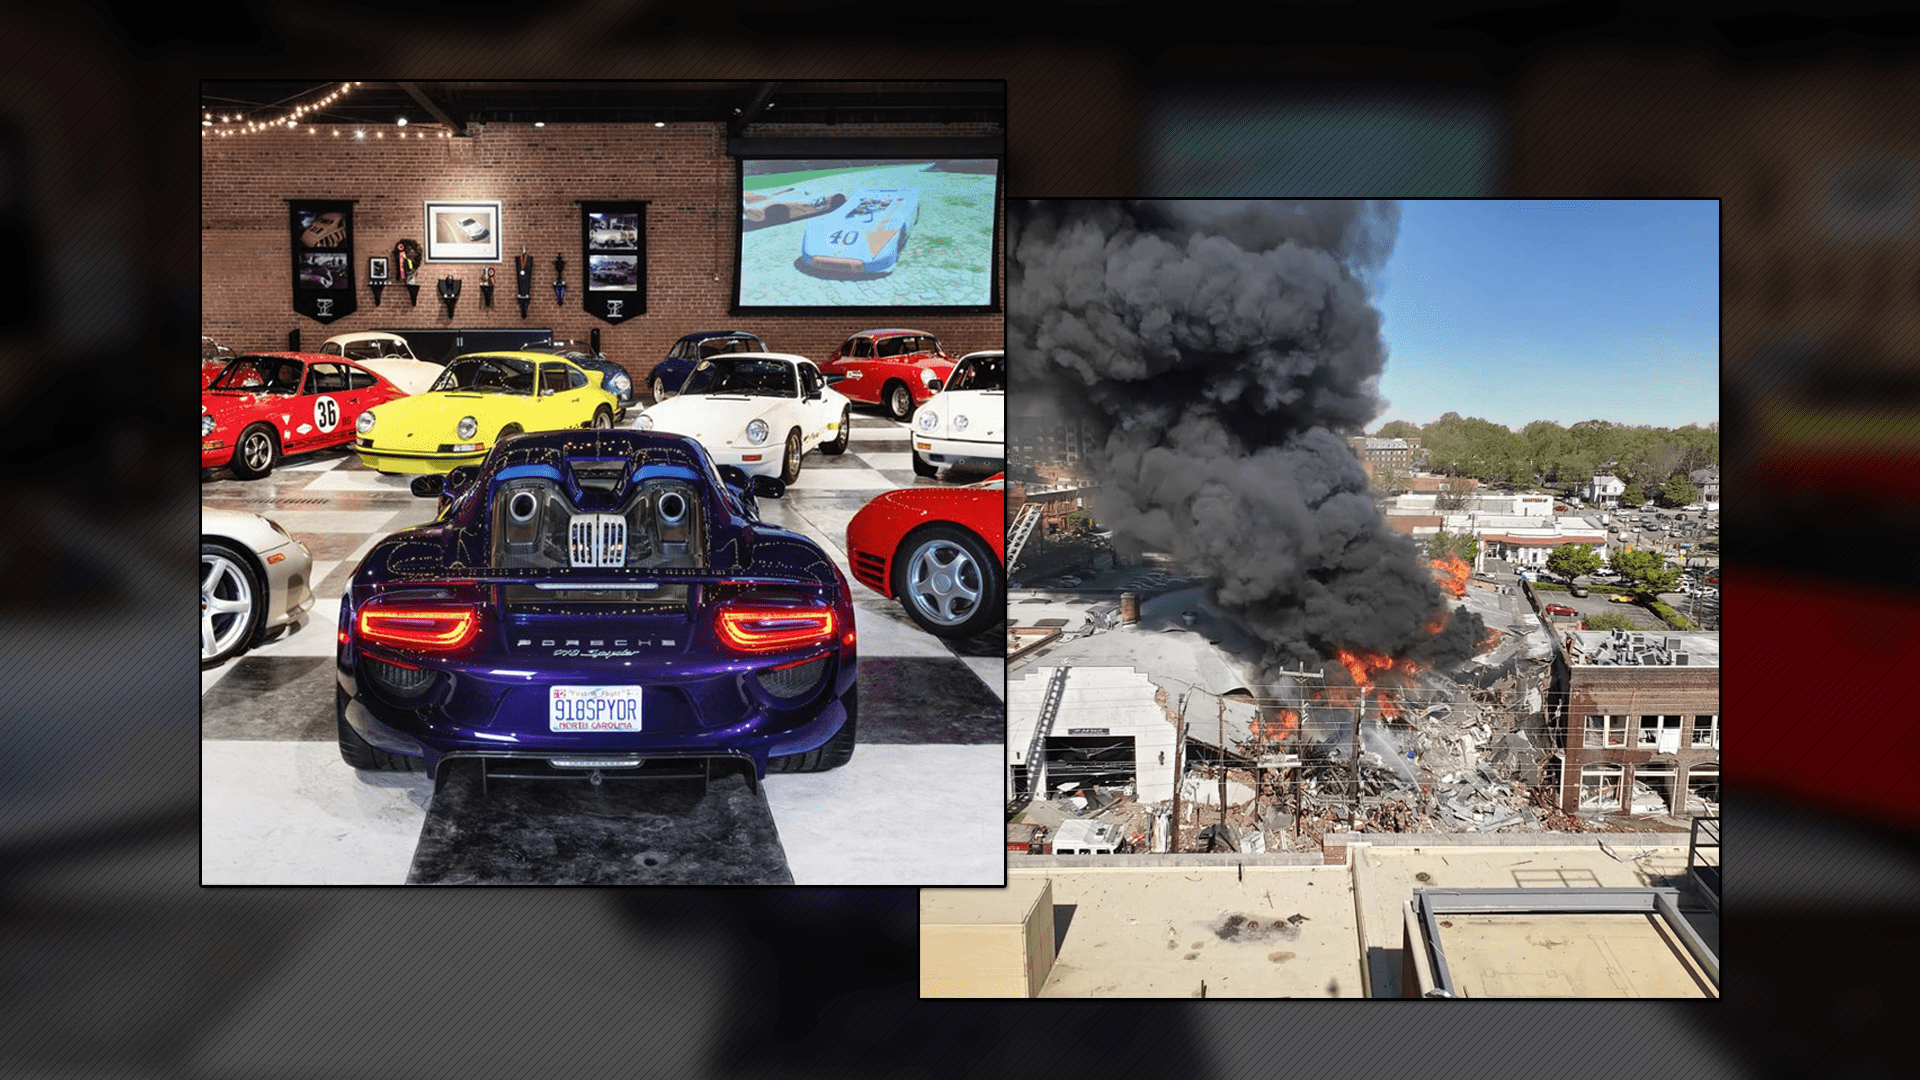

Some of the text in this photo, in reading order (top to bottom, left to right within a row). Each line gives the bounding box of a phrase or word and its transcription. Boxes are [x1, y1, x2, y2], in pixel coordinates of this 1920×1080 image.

[829, 230, 859, 245] 40
[318, 400, 336, 428] 36
[555, 699, 637, 721] 918SPYDR
